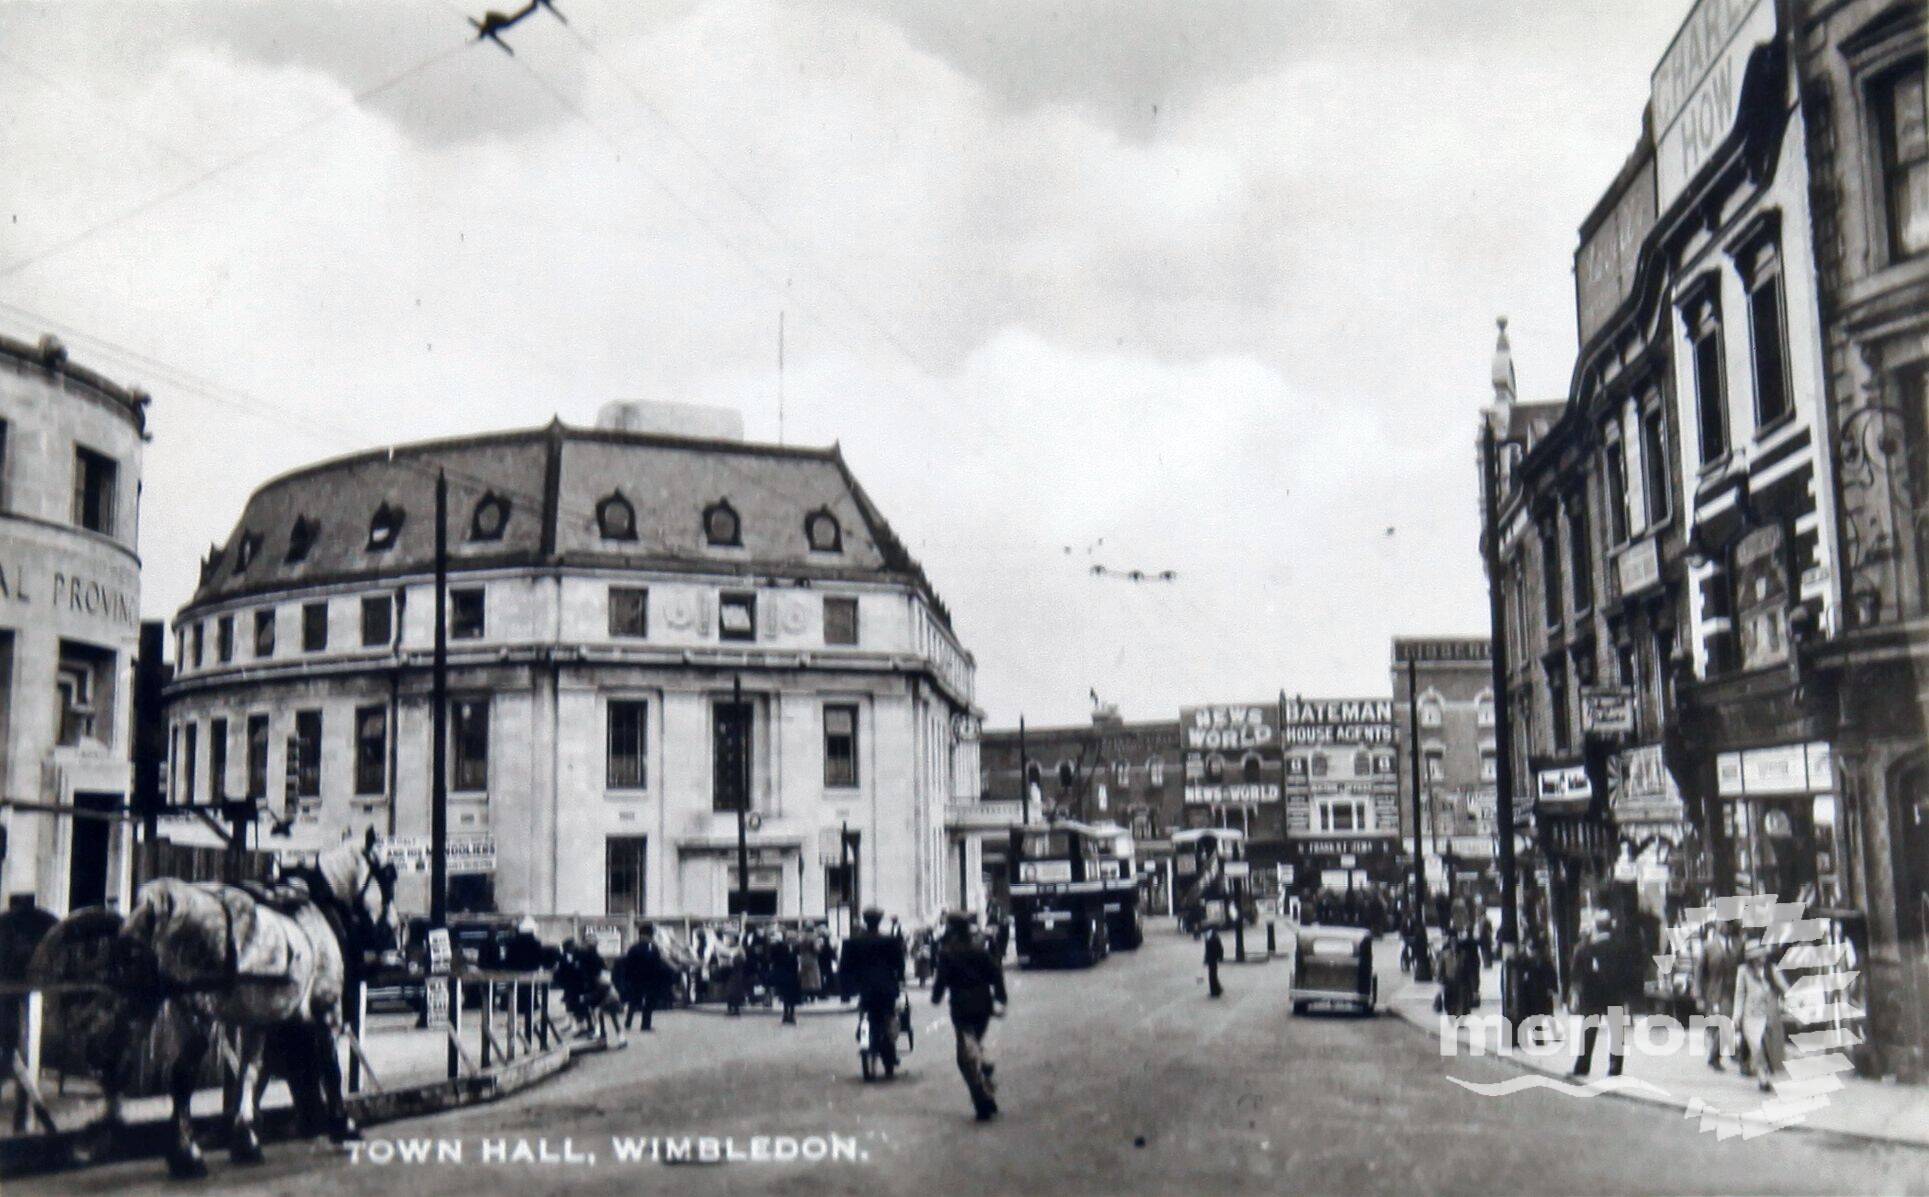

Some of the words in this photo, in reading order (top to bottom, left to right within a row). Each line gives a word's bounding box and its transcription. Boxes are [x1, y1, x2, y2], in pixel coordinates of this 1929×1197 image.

[1680, 54, 1733, 181] HOW
[1195, 706, 1264, 730] NEWS
[1286, 701, 1392, 724] BATEMAN
[1188, 723, 1273, 751] WORLD
[1286, 726, 1333, 744] HOUSE
[1336, 725, 1392, 744] AGENTS
[1230, 783, 1279, 803] WORLD
[425, 843, 495, 858] MNDOLIERS
